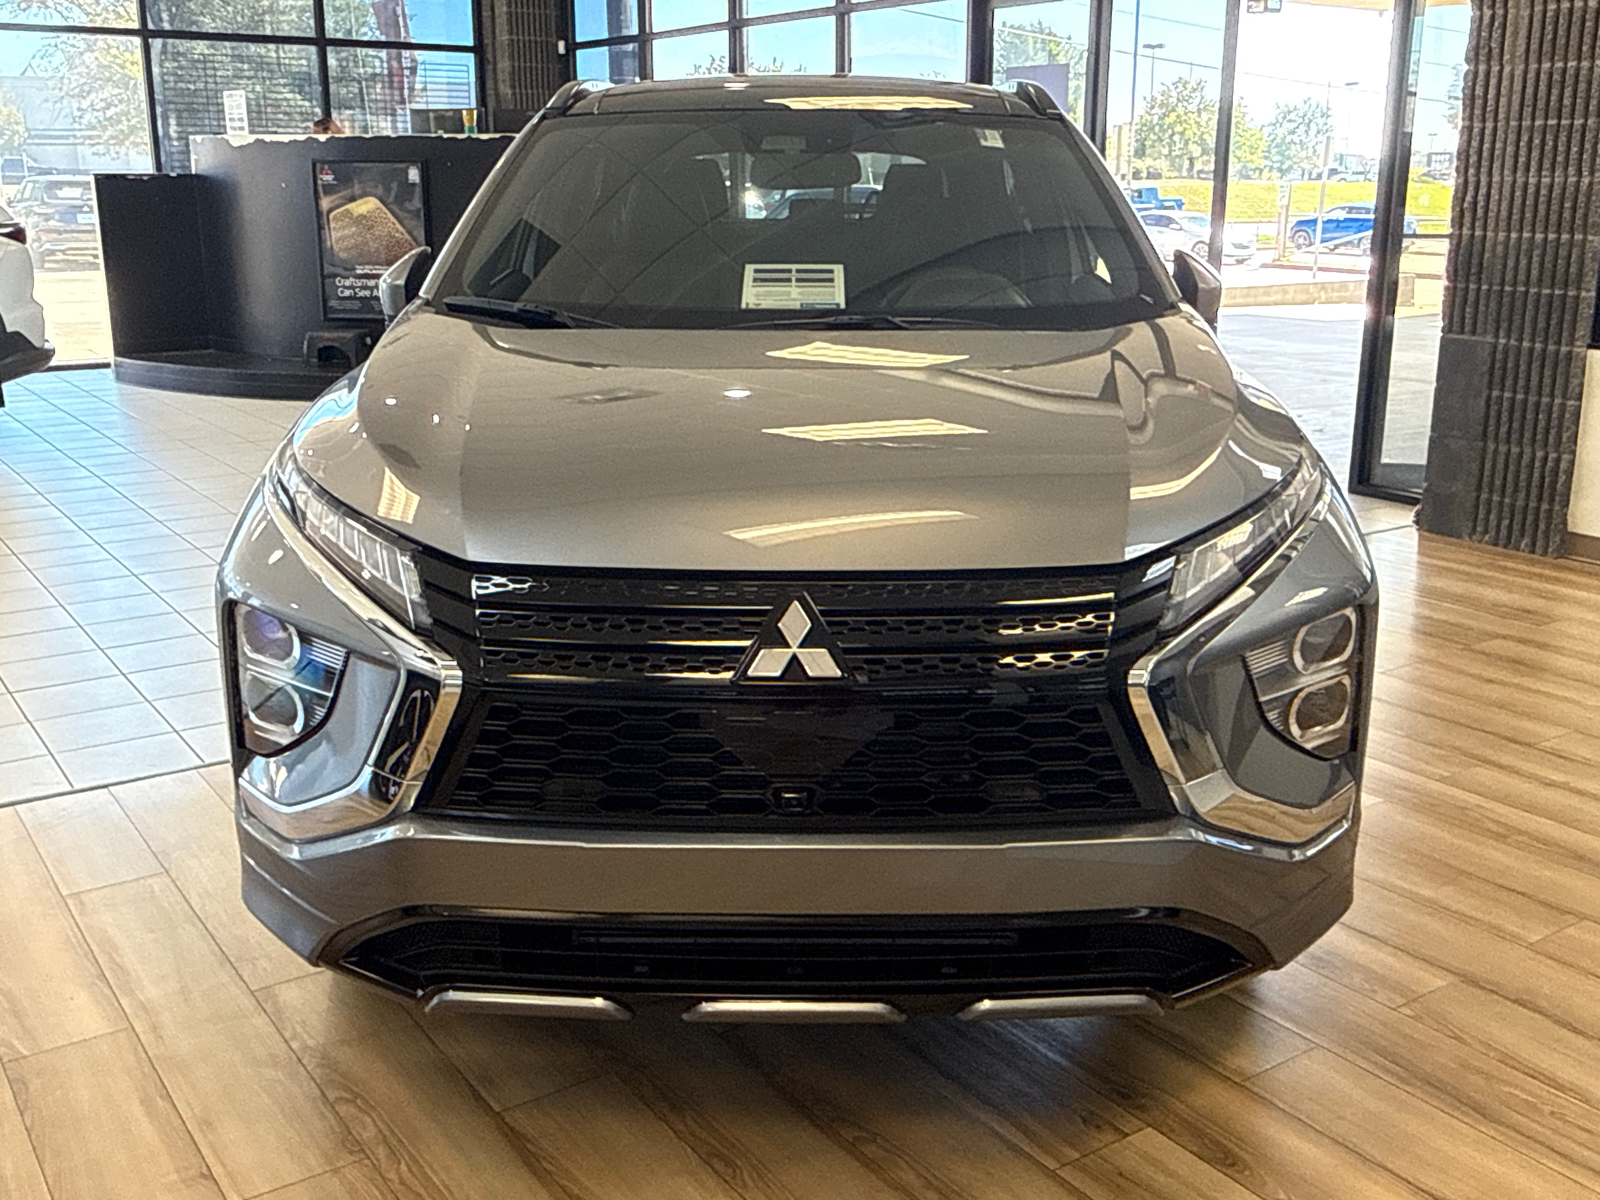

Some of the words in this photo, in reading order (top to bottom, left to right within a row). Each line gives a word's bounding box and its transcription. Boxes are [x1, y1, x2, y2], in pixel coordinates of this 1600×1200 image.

[335, 277, 380, 286] Craftsman
[338, 288, 354, 297] Can
[355, 288, 371, 297] See
